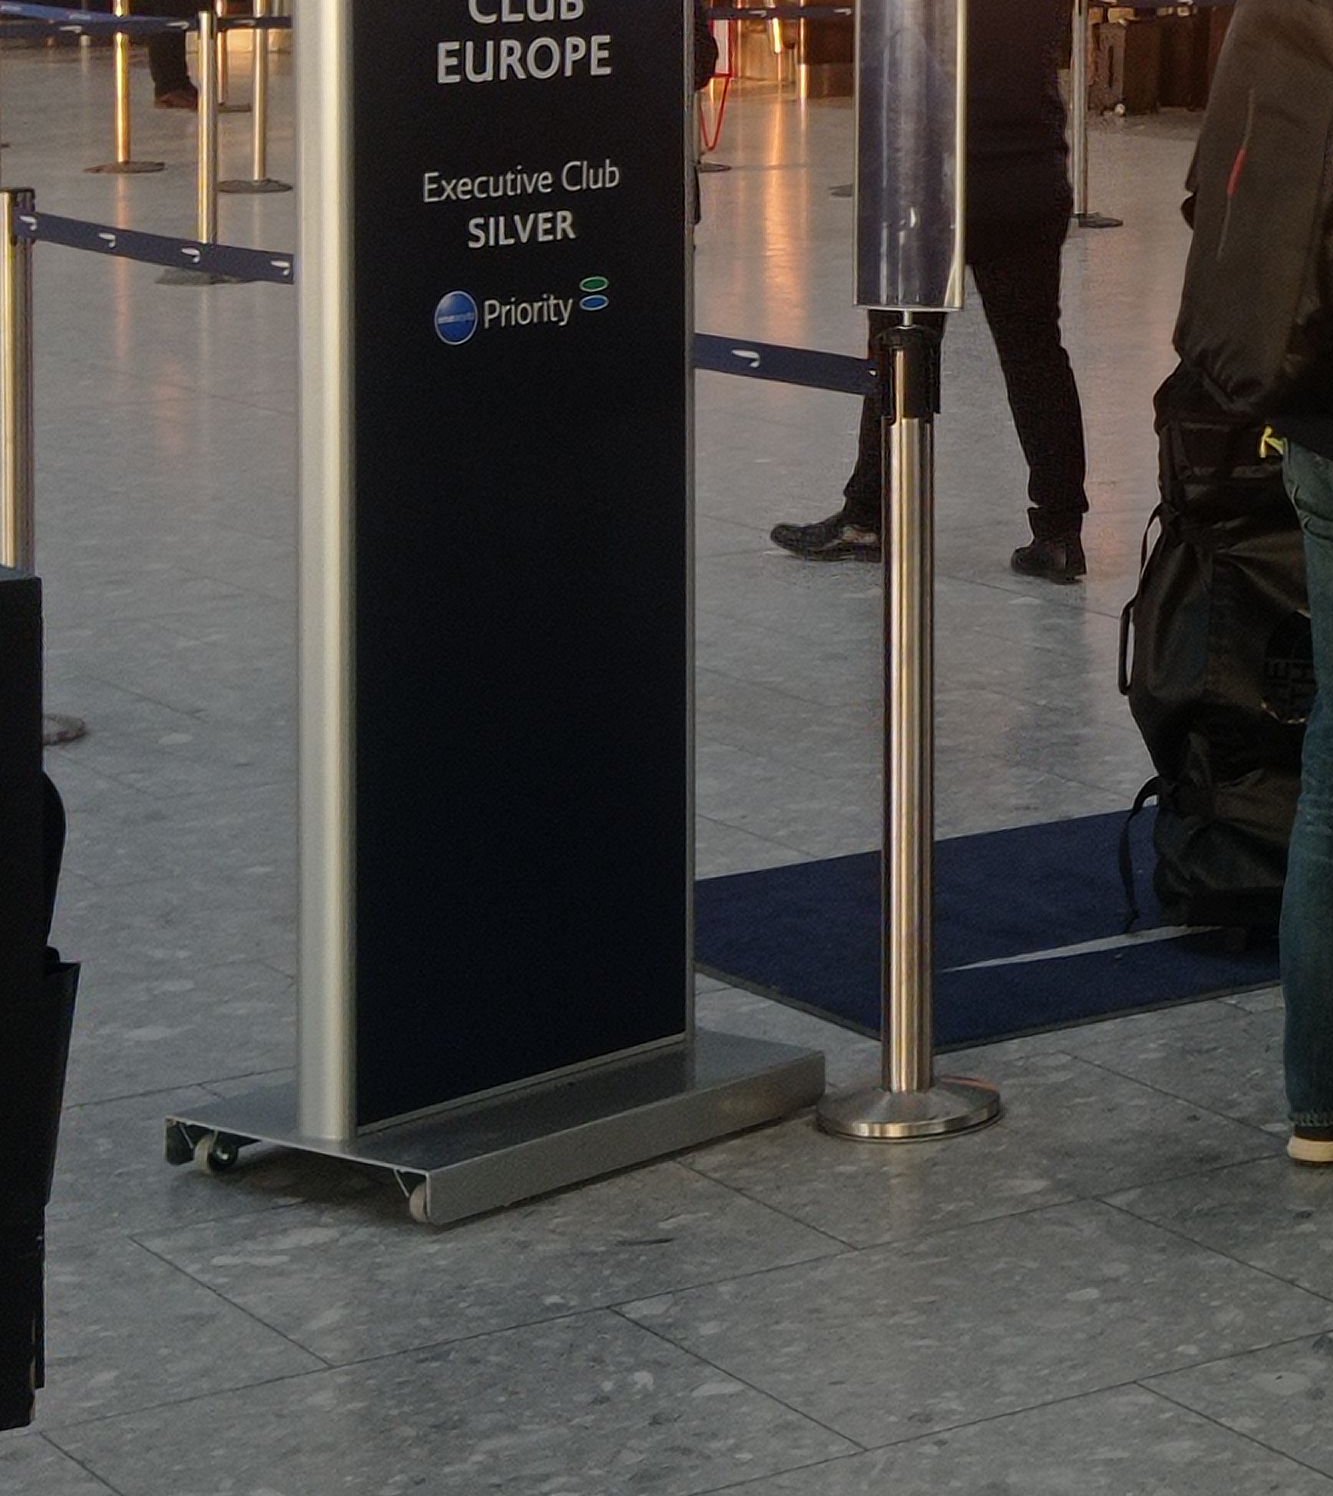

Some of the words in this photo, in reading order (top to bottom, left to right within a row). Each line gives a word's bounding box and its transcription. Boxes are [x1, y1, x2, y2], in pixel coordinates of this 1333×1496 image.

[436, 34, 613, 84] EUROPE
[423, 165, 553, 203] Executive
[561, 158, 620, 192] Club
[467, 209, 576, 249] SILVER
[483, 293, 574, 329] Priority
